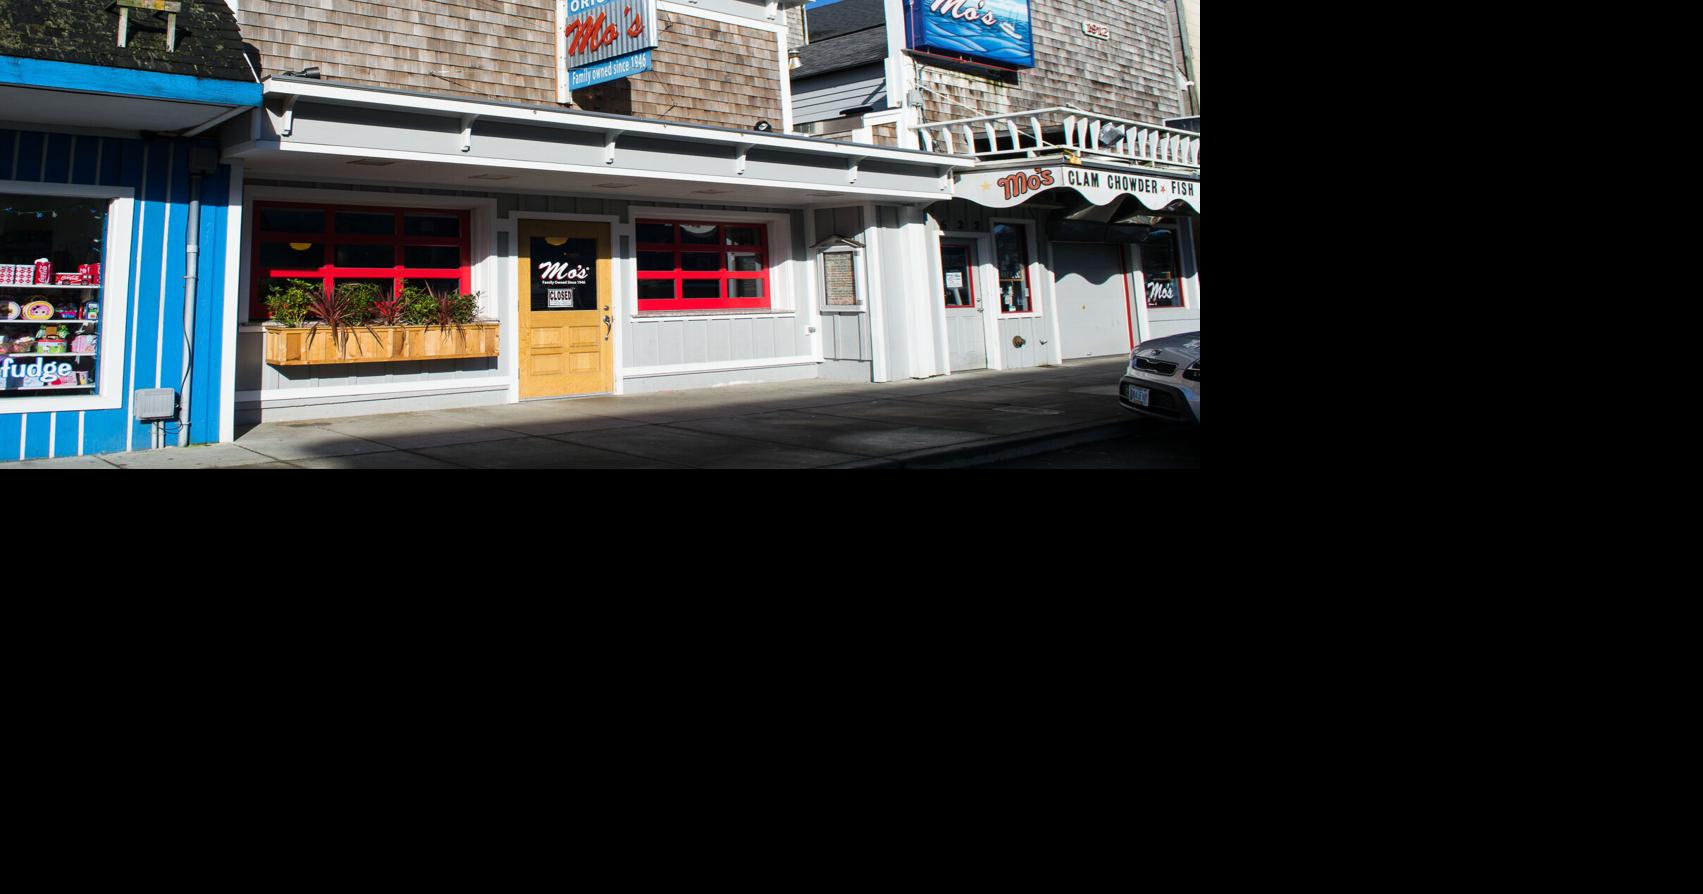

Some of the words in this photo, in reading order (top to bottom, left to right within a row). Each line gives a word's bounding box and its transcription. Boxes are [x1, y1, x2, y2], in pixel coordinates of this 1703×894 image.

[930, 0, 998, 27] Mo's
[565, 6, 645, 56] Mo's
[572, 70, 592, 85] Family
[592, 62, 612, 78] owned
[613, 62, 630, 75] since
[631, 53, 647, 69] 1946
[997, 167, 1055, 201] Mo's
[1068, 170, 1099, 188] CLAM
[1107, 174, 1158, 194] CHOWDER
[1171, 181, 1194, 196] FISH
[538, 261, 589, 280] Mo's
[550, 291, 571, 300] CLOSED
[1147, 281, 1174, 302] Mo's
[0, 356, 73, 383] fudge
